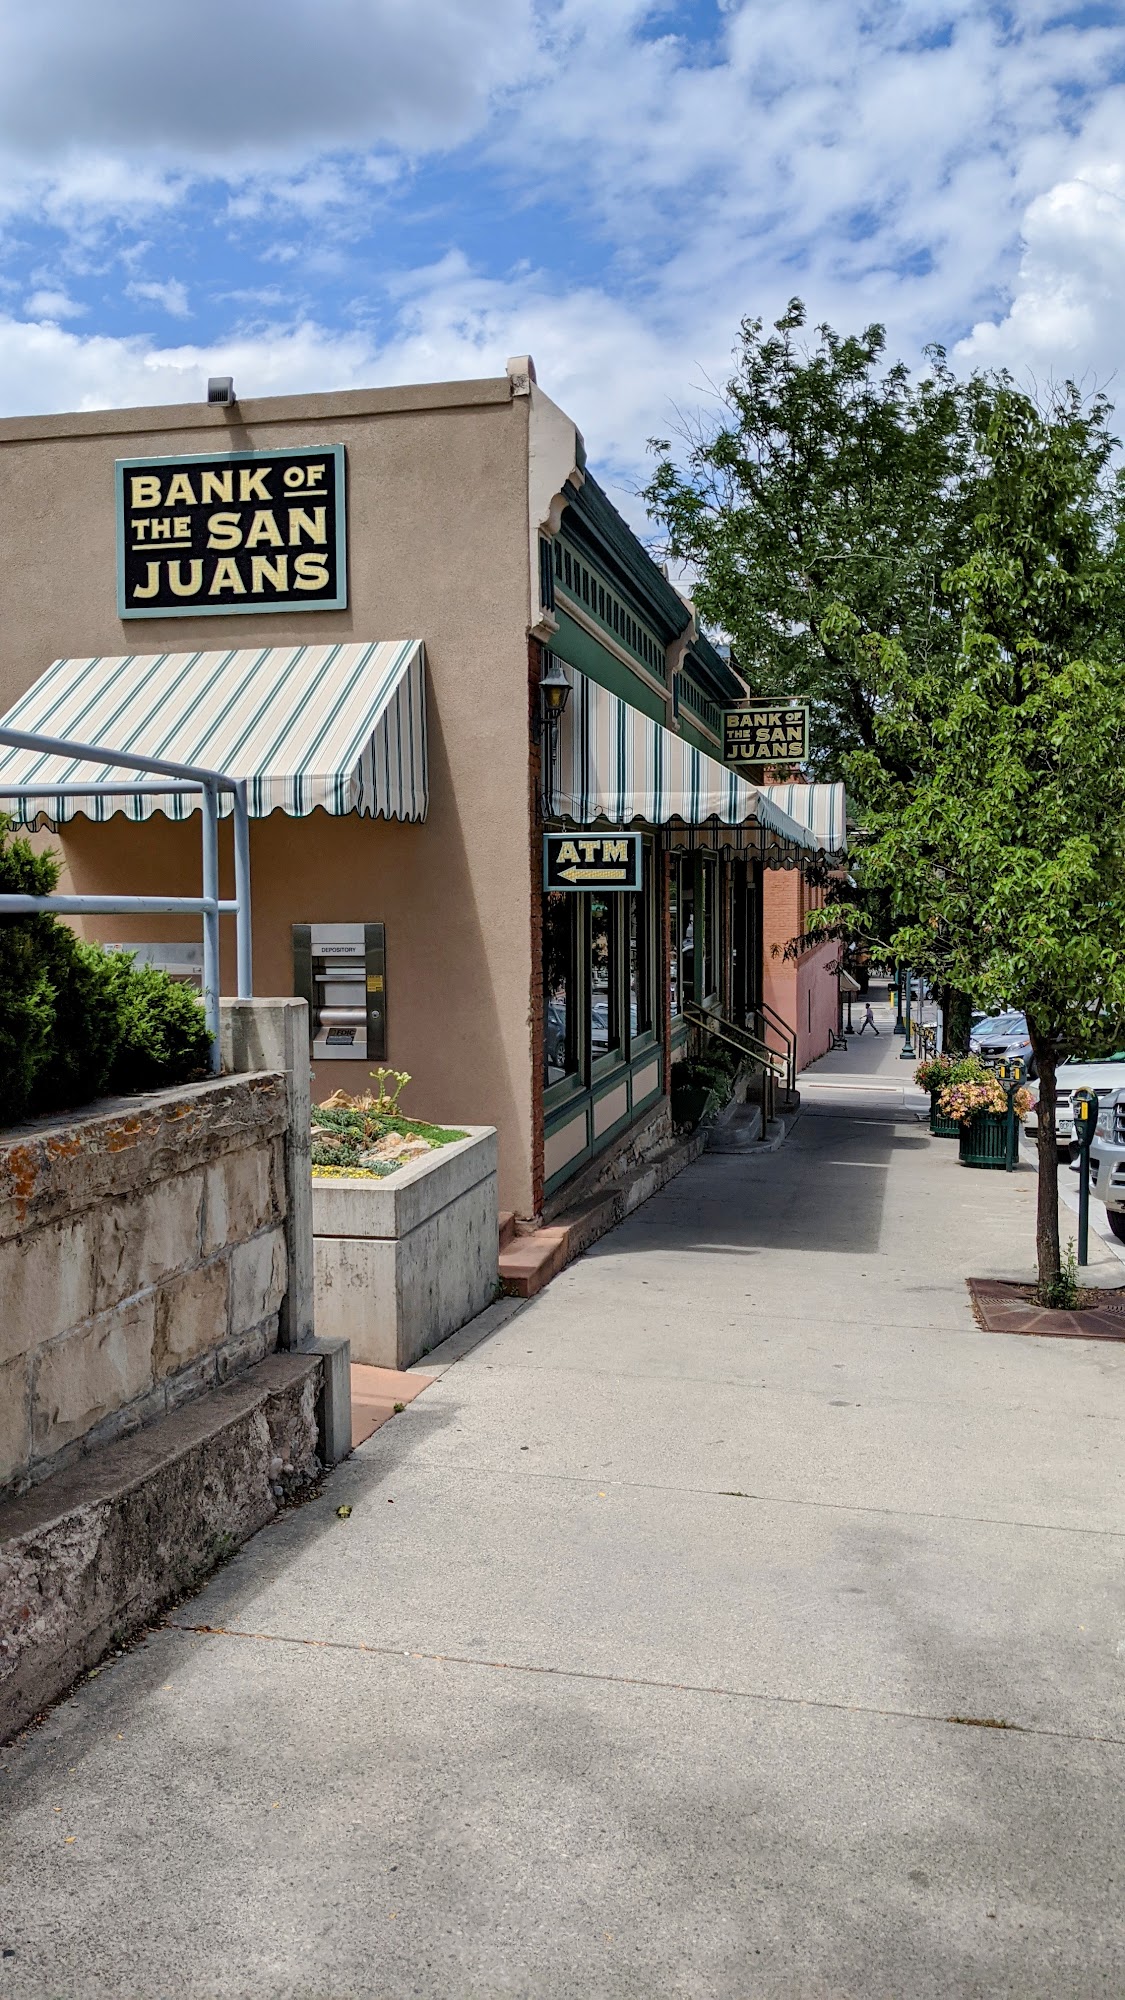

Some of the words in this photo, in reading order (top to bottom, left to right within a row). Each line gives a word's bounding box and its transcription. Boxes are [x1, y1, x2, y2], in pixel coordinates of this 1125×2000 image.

[131, 467, 273, 509] BANK
[283, 463, 326, 488] OF
[131, 515, 192, 541] THE
[206, 506, 327, 550] SAN
[133, 553, 330, 598] JUANS
[726, 712, 783, 728] BANK
[785, 712, 803, 721] OF
[726, 729, 751, 738] THE
[755, 726, 803, 742] SAN
[726, 742, 804, 759] JUANS
[556, 839, 629, 864] ATM
